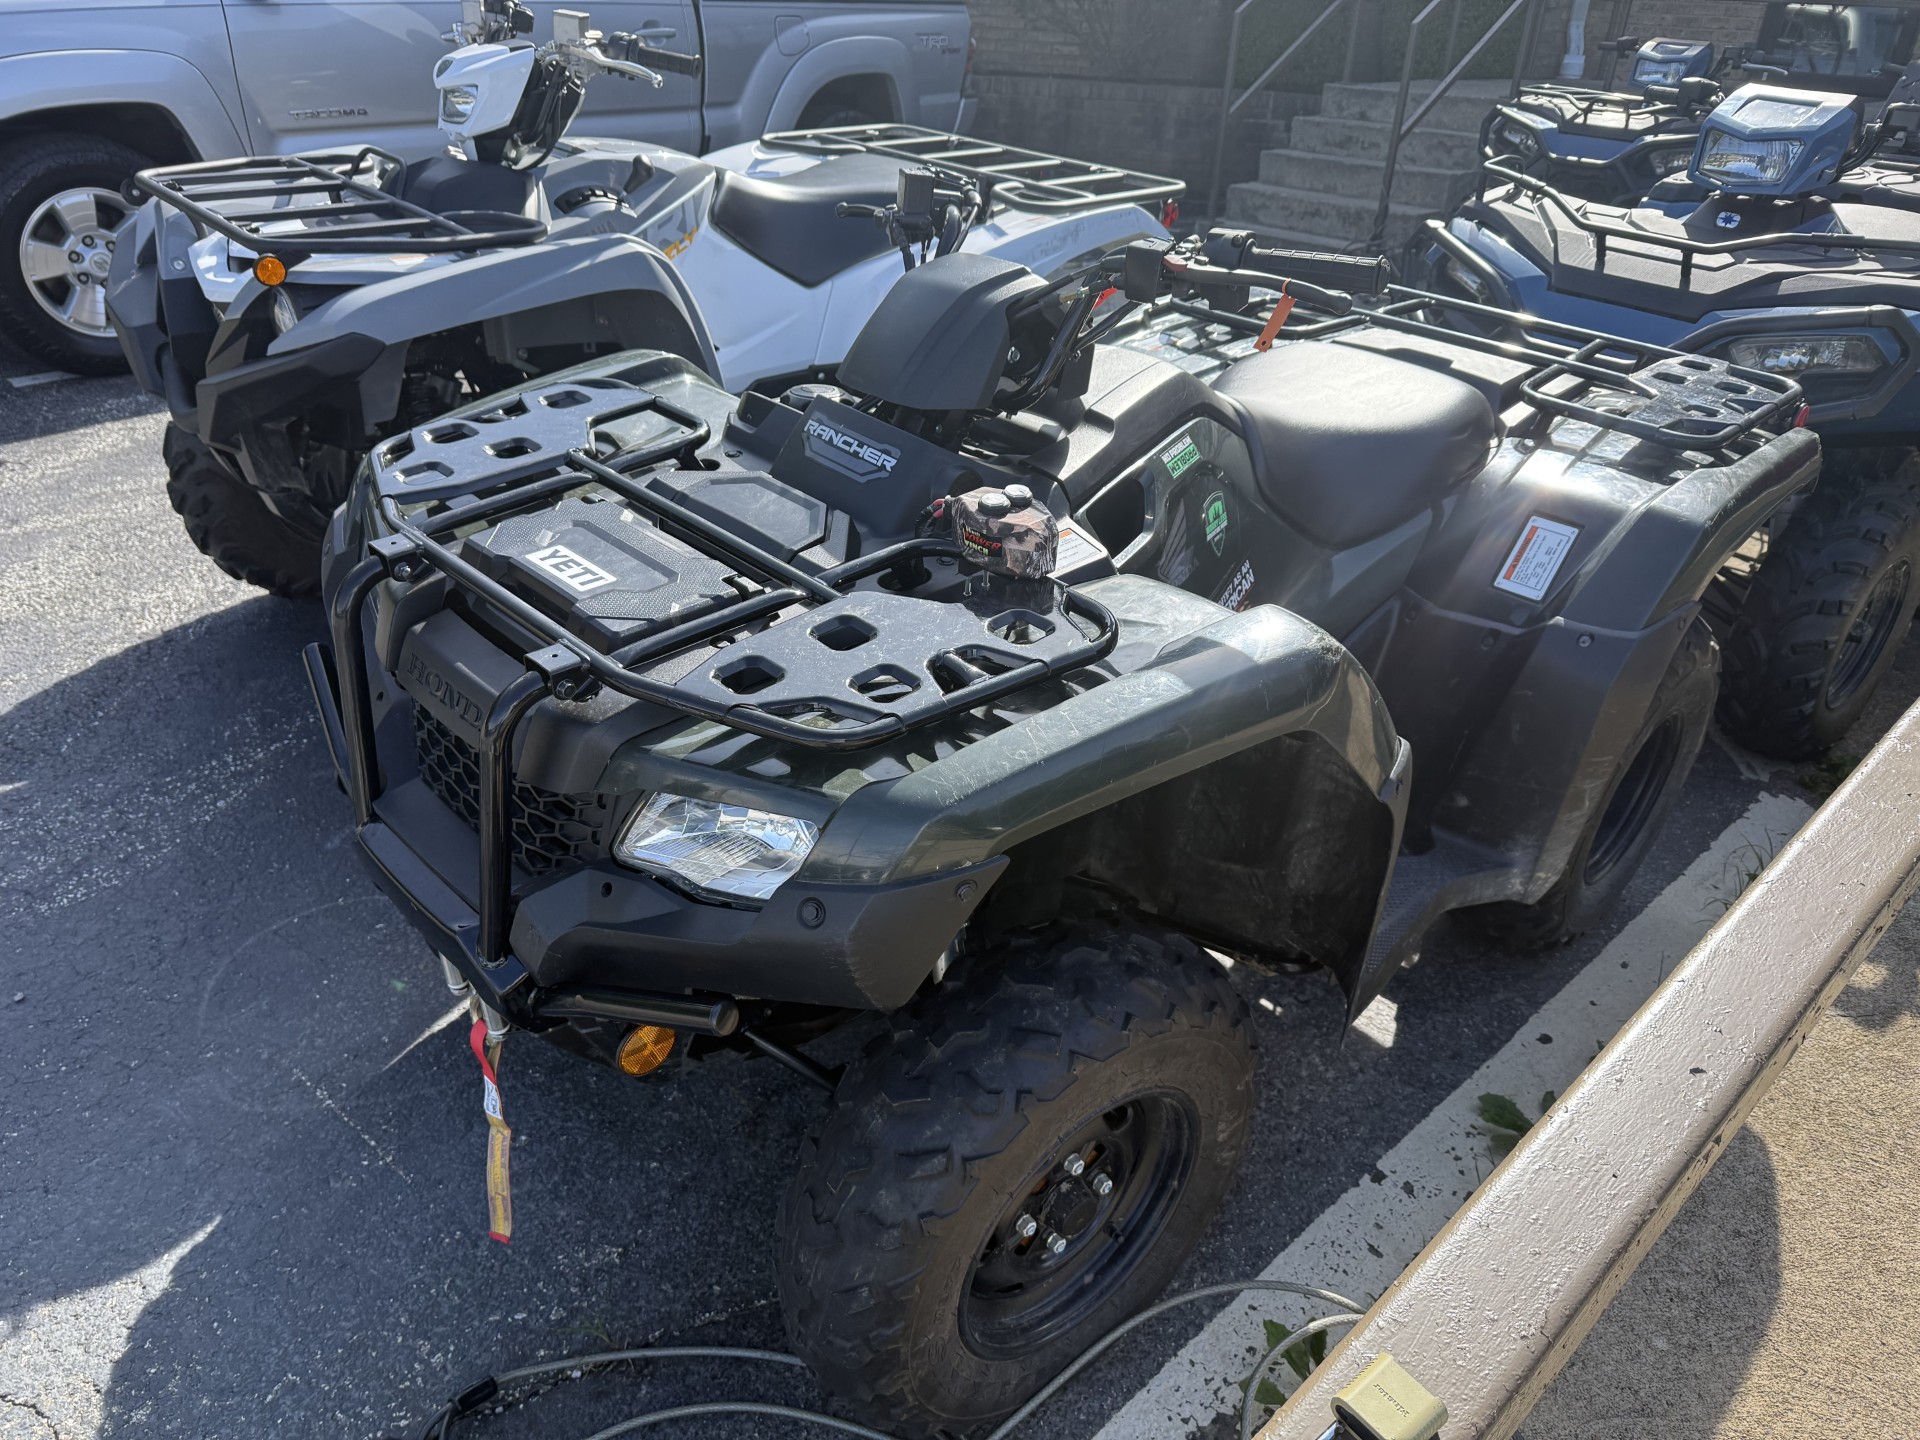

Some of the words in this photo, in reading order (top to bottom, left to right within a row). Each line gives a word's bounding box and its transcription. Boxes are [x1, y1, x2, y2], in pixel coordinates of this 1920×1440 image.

[919, 35, 949, 49] TRD
[287, 106, 369, 121] TACOMA
[803, 419, 898, 473] RANCHER
[1168, 445, 1199, 475] PROBLEM
[964, 530, 1002, 551] POWER
[538, 548, 607, 587] YETI
[1233, 571, 1242, 588] AS
[1241, 559, 1251, 576] AN
[406, 651, 483, 730] HOND
